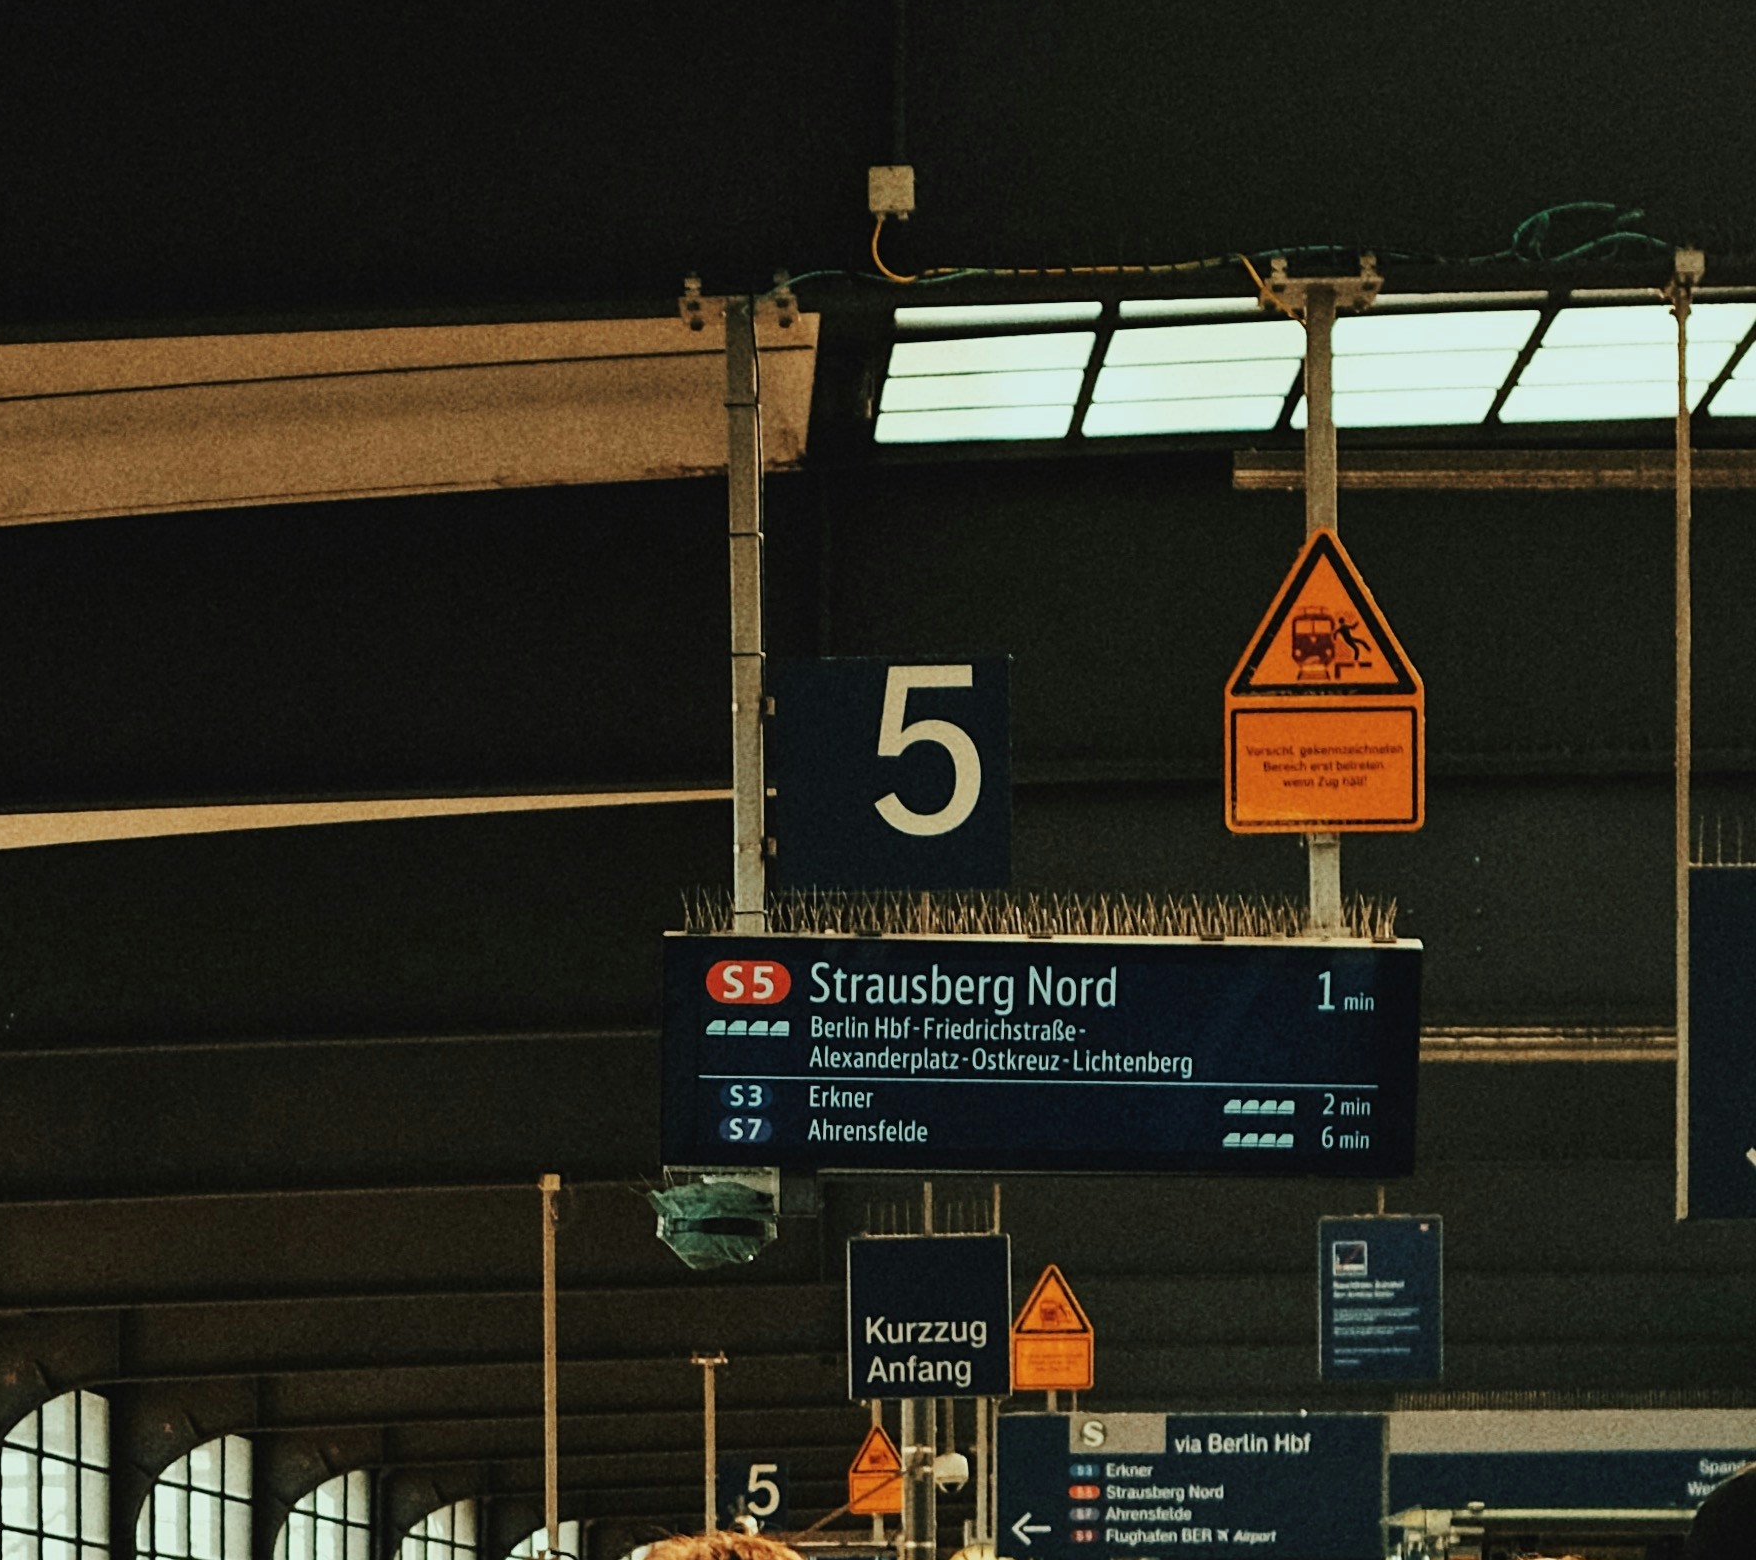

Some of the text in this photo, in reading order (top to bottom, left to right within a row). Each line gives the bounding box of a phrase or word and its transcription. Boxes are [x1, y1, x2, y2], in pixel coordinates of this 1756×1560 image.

[874, 665, 982, 836] 5
[1263, 761, 1307, 773] Bereich
[1318, 775, 1339, 789] Zug
[809, 961, 1014, 1017] Strausberg
[1028, 965, 1117, 1008] Nord
[1318, 971, 1374, 1011] 1 min
[810, 1015, 868, 1039] Berlin
[809, 1086, 874, 1109] Erkner
[1322, 1093, 1371, 1116] 2 min
[807, 1119, 929, 1143] Ahrensfelde
[1321, 1126, 1370, 1150] 6 min
[866, 1316, 987, 1348] Kurzzug
[867, 1354, 972, 1387] Anfang
[1082, 1420, 1106, 1447] S
[1175, 1433, 1311, 1453] via Berlin Hbf
[1106, 1462, 1153, 1477] Erkner
[747, 1463, 781, 1516] 5
[1106, 1485, 1185, 1503] Strausberg
[1189, 1485, 1224, 1500] Nord
[1106, 1506, 1193, 1521] Ahrensfelde
[1106, 1528, 1178, 1547] Flughafen
[1181, 1527, 1213, 1542] BER
[1233, 1529, 1277, 1545] Airport
